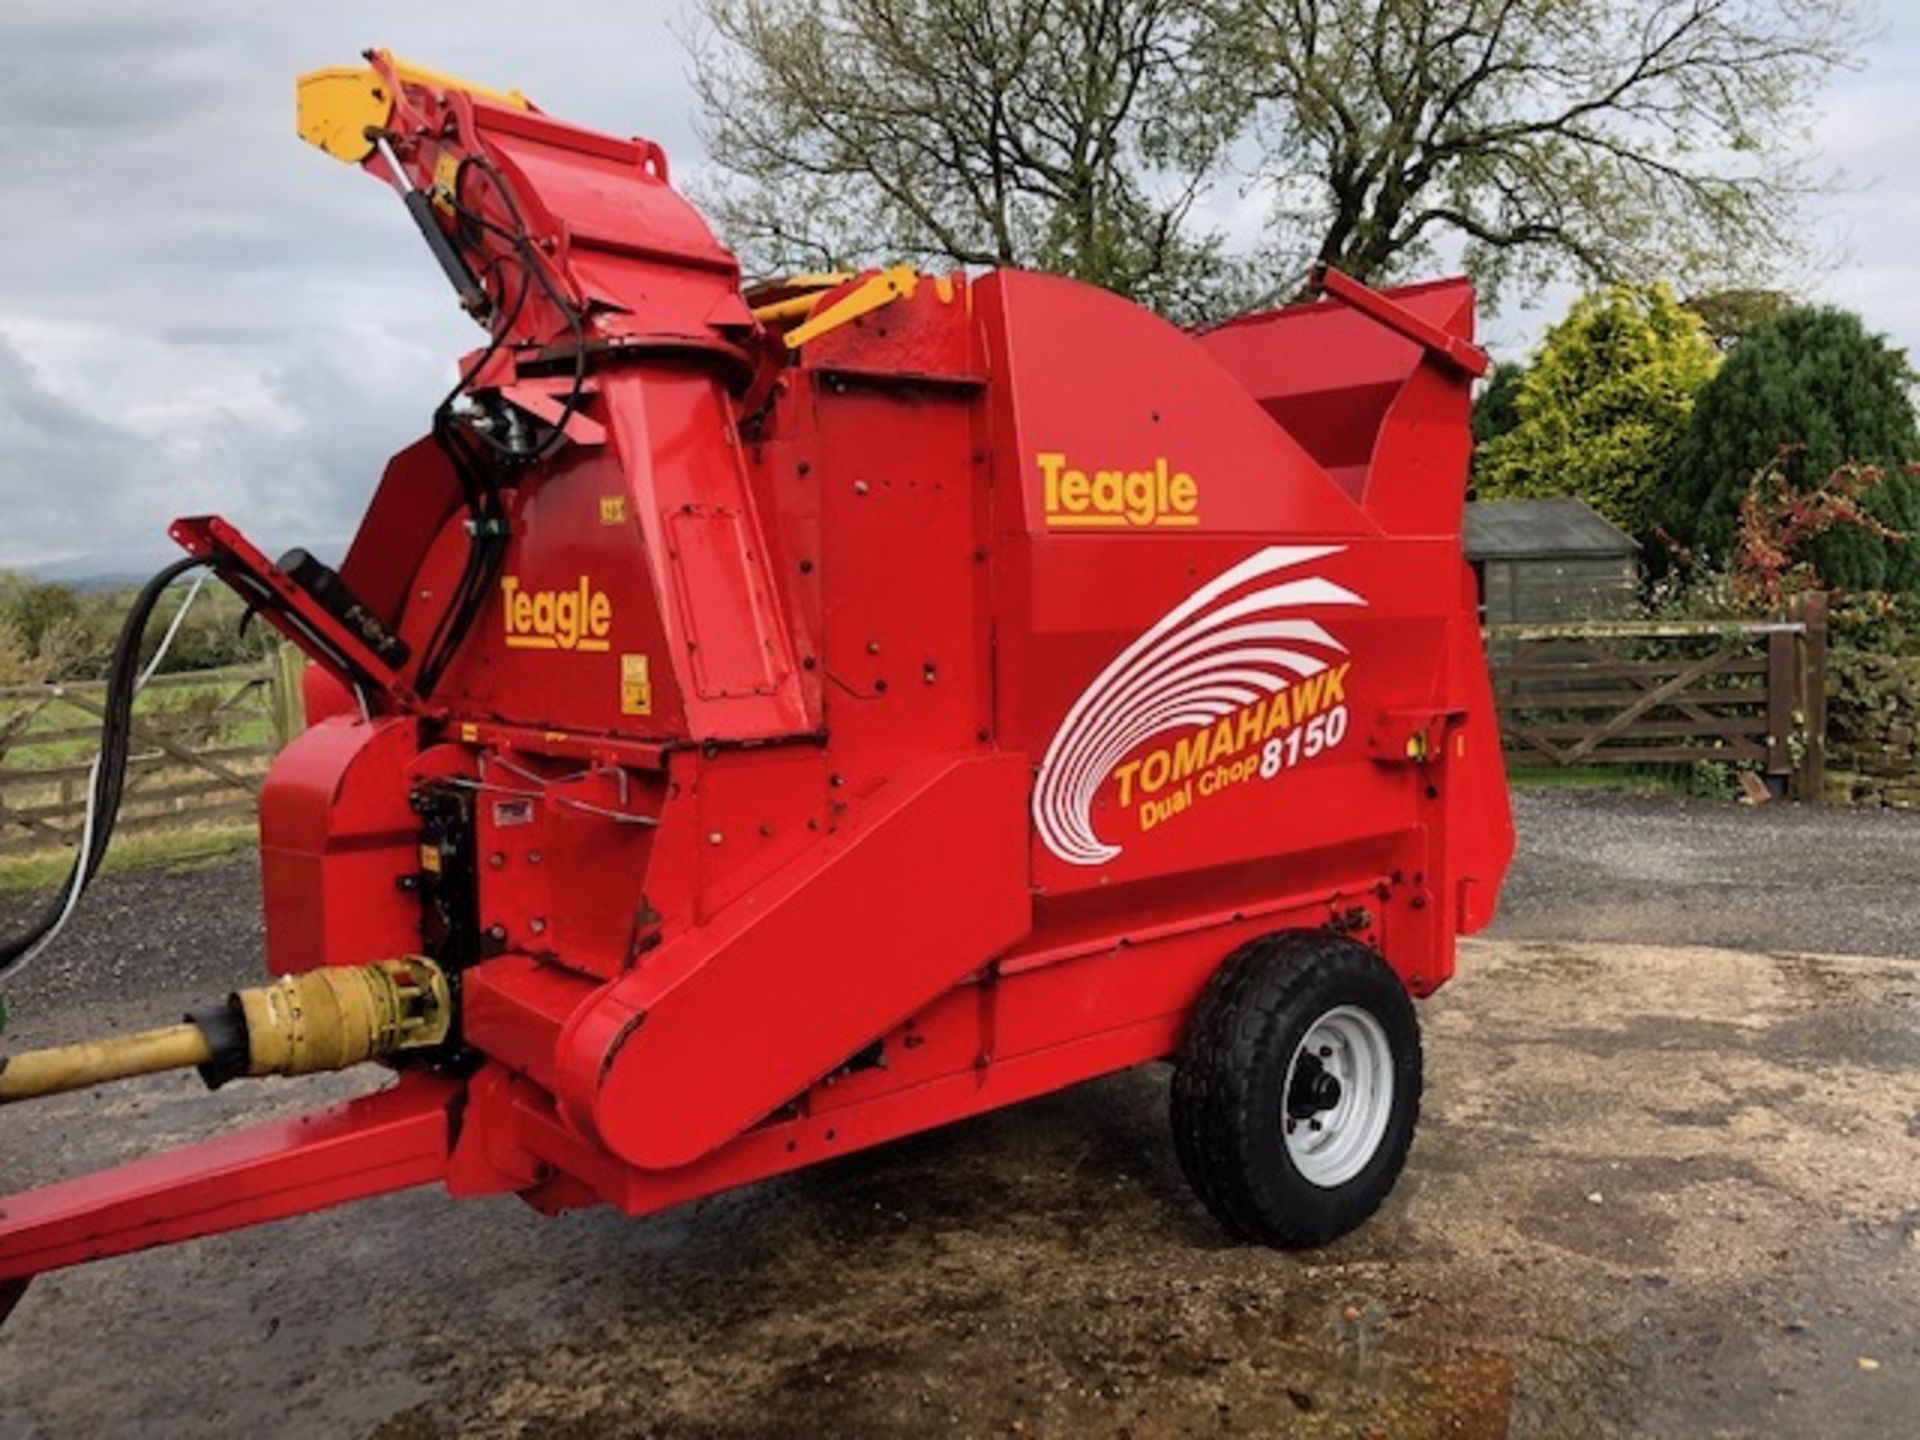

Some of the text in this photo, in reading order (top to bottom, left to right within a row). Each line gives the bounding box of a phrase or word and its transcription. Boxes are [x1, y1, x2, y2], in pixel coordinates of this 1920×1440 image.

[1037, 453, 1198, 526] Teagle
[501, 575, 612, 649] Teagle
[1114, 663, 1351, 807] TOMAHAWK
[1139, 706, 1348, 831] Dual Chop 8150
